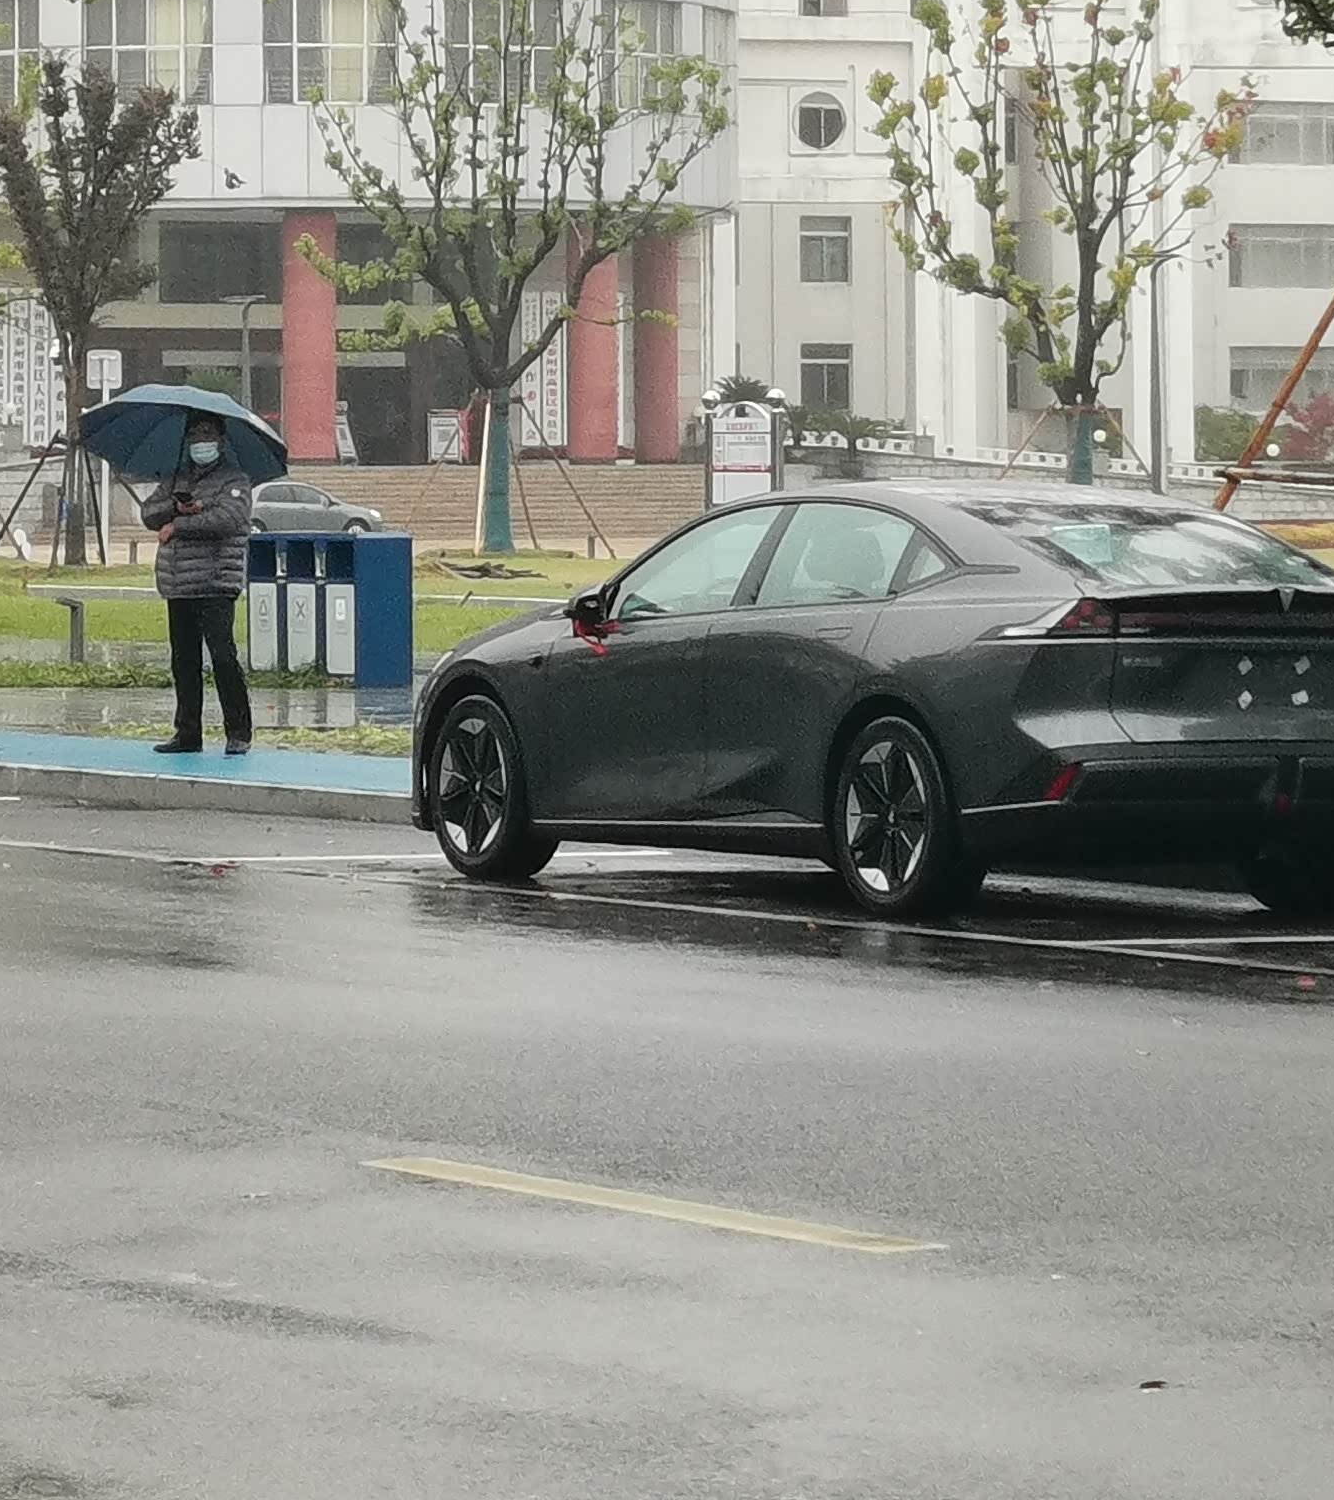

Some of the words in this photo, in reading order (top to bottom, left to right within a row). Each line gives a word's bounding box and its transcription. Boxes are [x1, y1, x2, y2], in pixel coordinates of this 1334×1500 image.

[33, 303, 46, 443] 州市高港区人民政府
